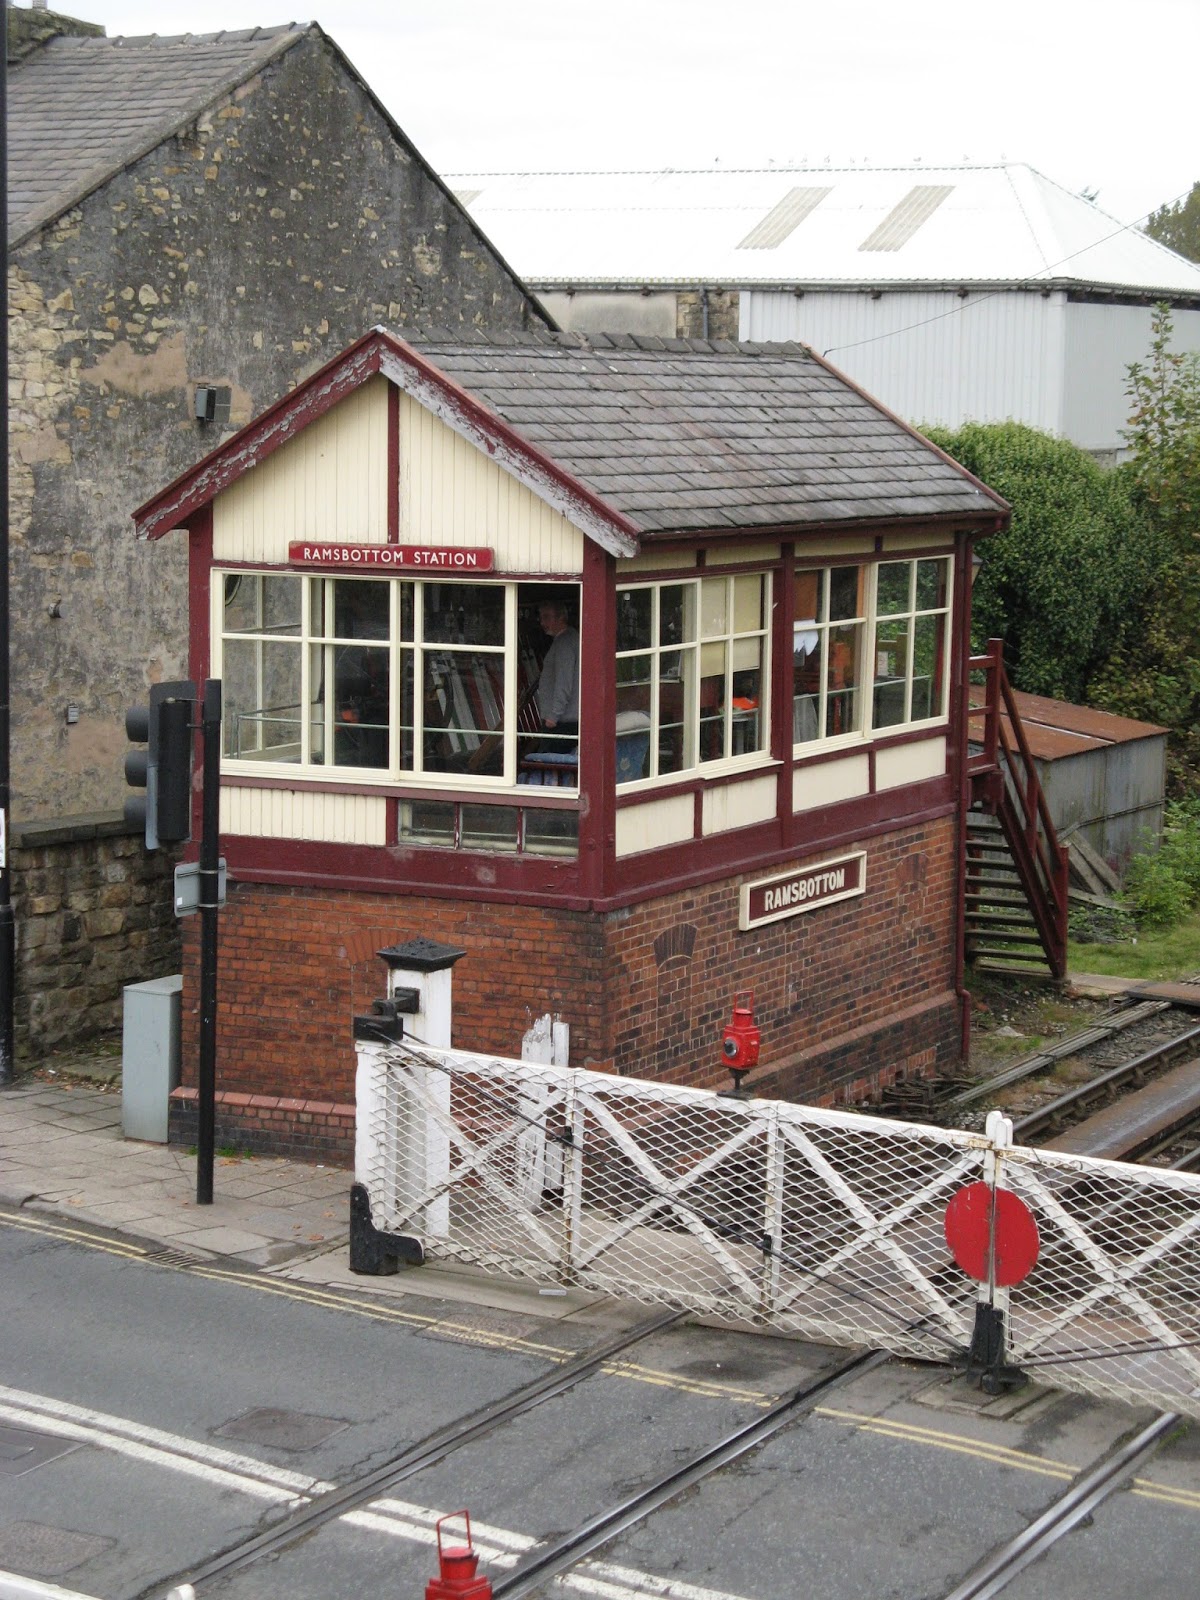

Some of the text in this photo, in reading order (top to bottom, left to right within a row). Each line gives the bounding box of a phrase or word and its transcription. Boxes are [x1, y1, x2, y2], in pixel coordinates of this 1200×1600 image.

[304, 548, 477, 566] RAMSBOTTOM STATION
[764, 868, 845, 911] RAMSBOTTOM
